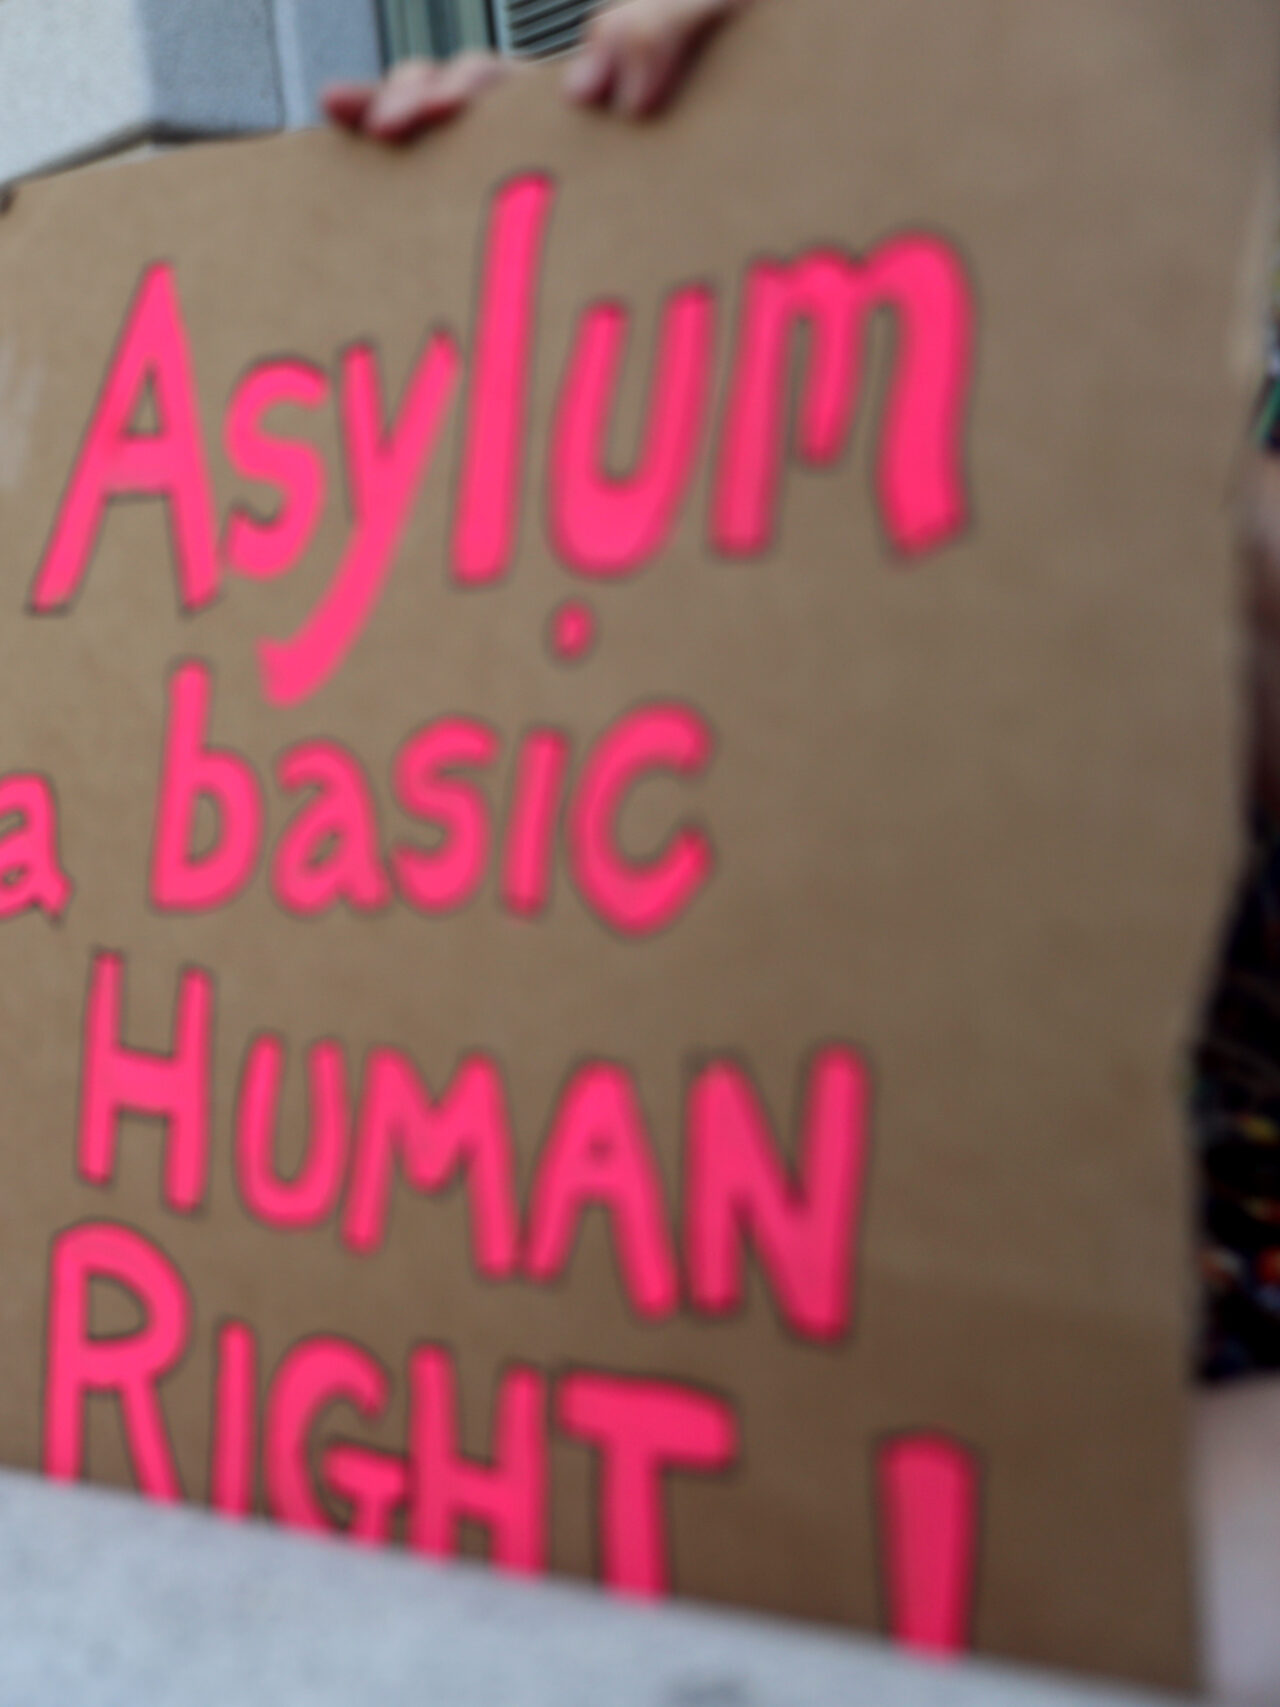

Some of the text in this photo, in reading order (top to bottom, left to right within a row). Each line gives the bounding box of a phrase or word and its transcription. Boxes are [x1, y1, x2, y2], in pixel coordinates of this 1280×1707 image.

[31, 171, 977, 707] Asylum
[148, 604, 714, 938] basic
[74, 950, 870, 1340] HUMAN
[40, 1221, 738, 1602] RIGHT
